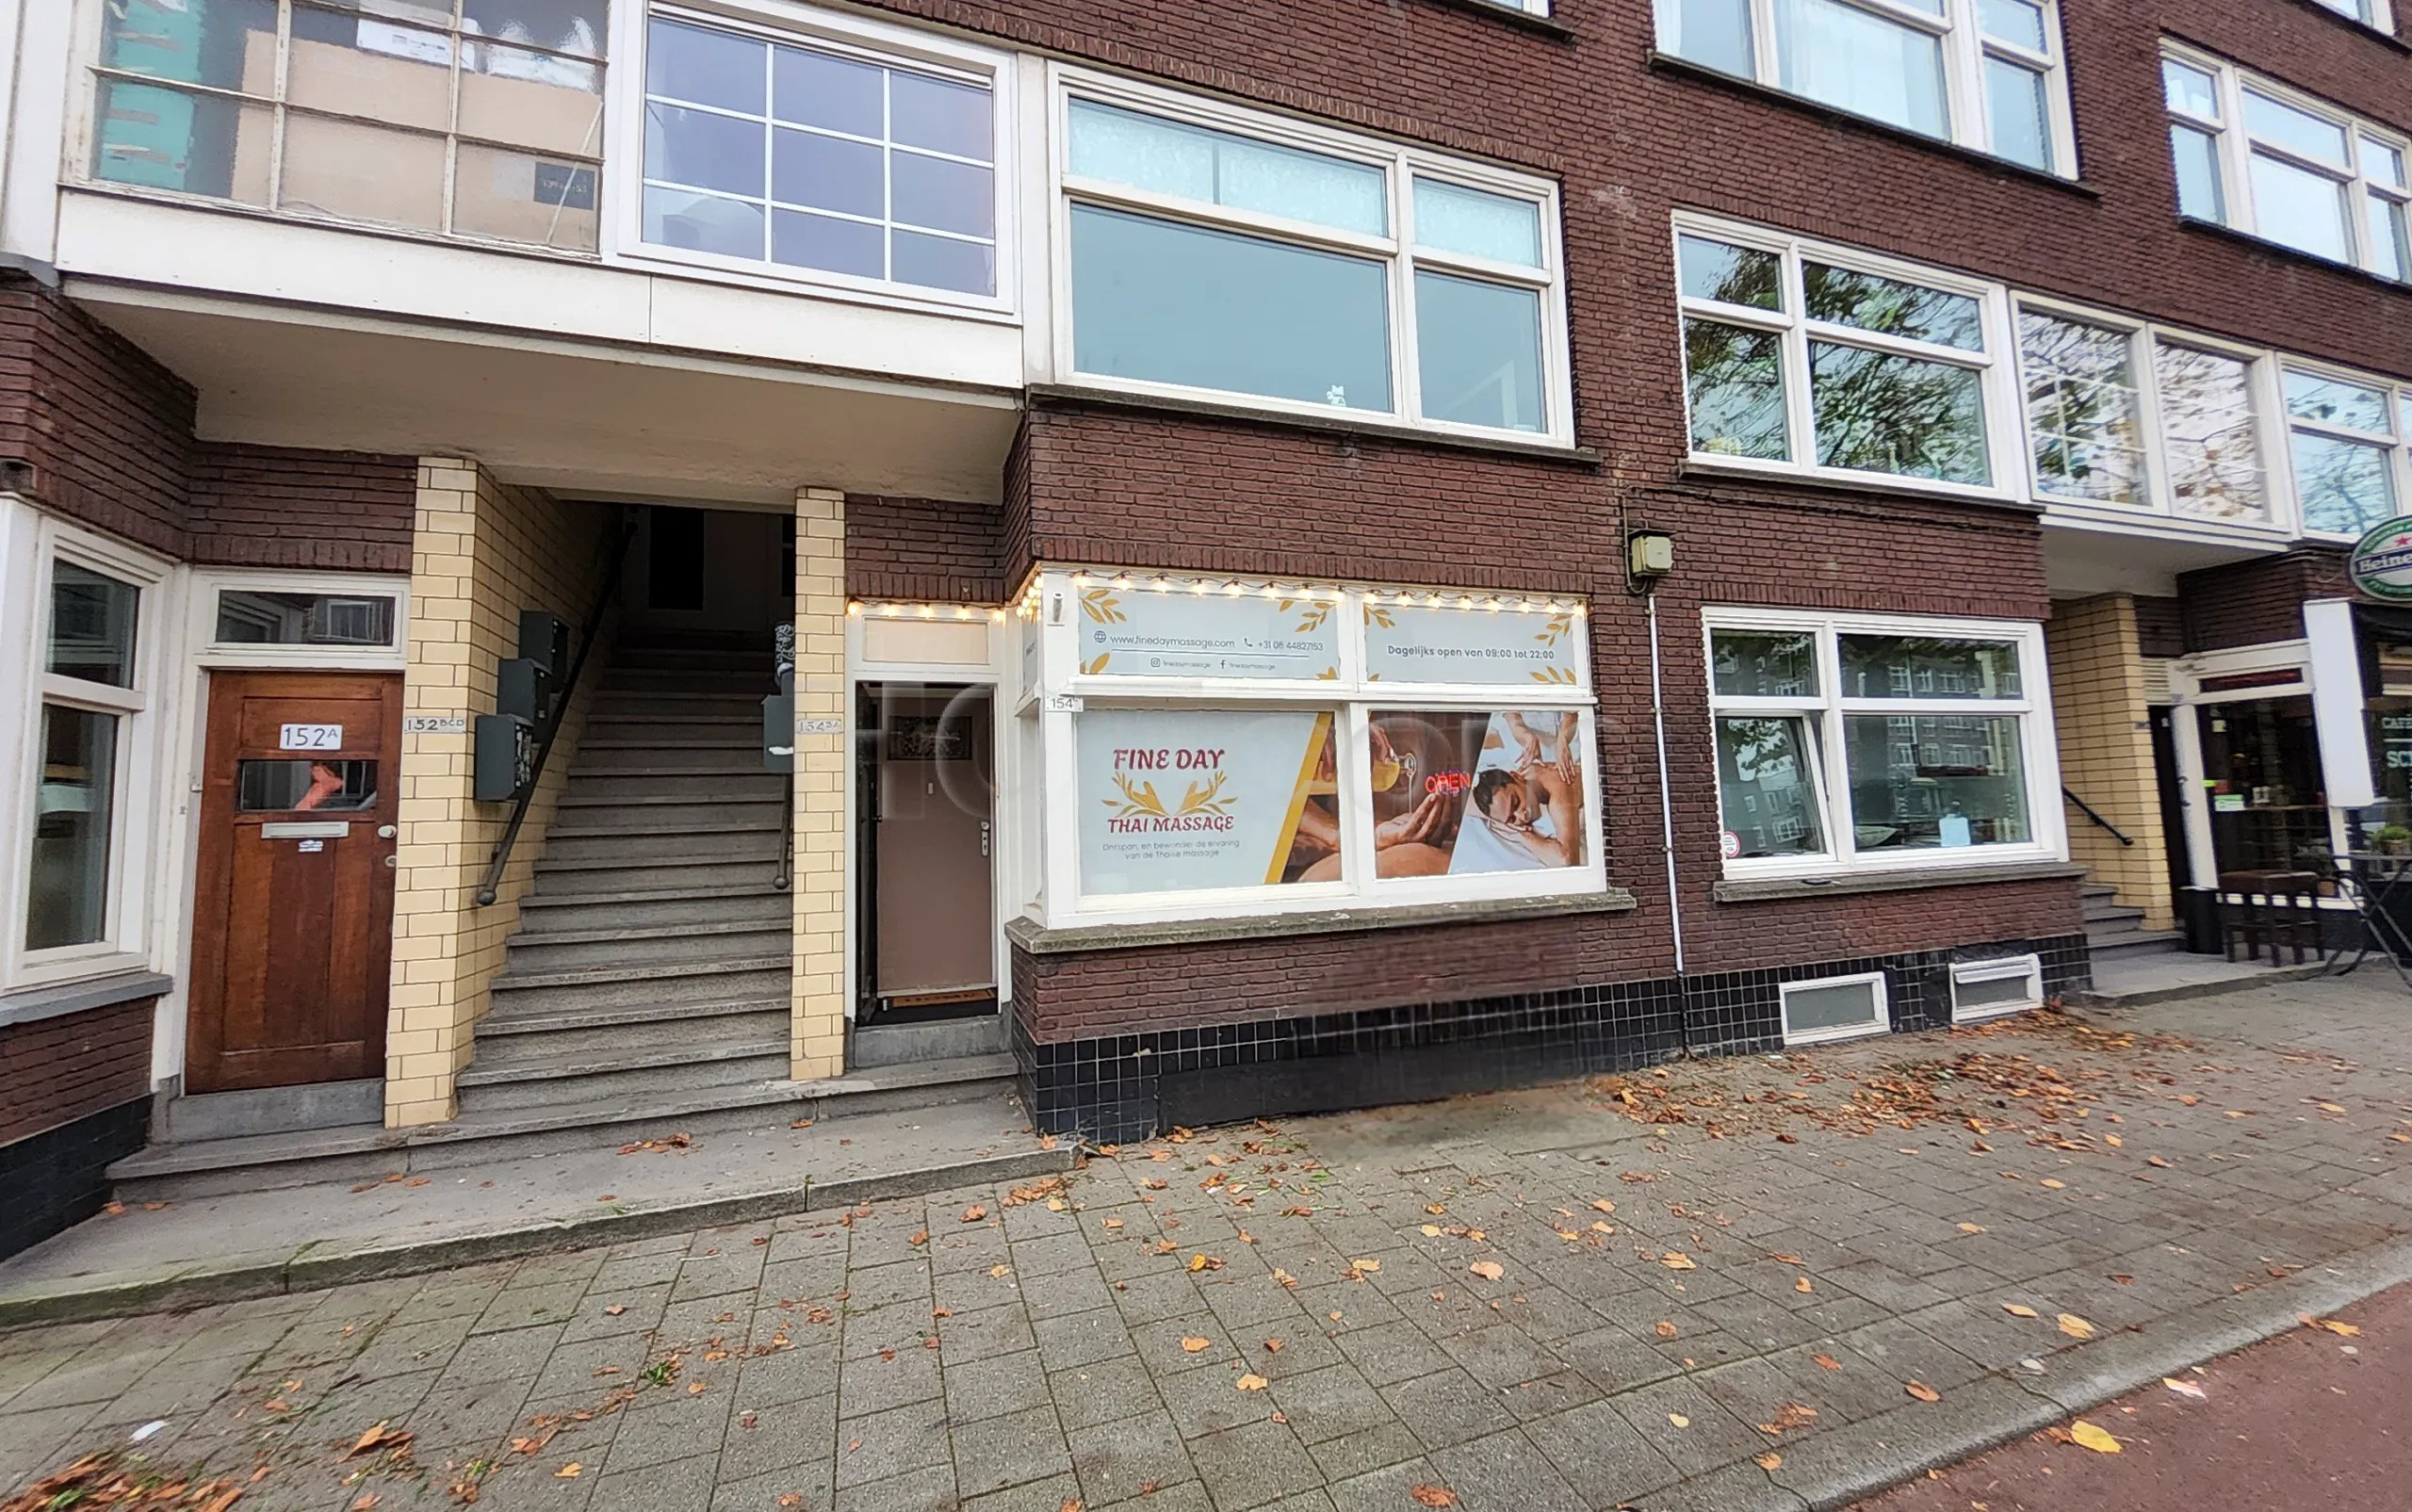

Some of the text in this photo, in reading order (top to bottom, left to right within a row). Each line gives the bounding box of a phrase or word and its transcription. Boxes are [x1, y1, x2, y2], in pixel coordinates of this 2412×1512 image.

[1110, 635, 1235, 649] www.finedaymassage.com
[1388, 645, 1555, 659] Dagelijks open van 09:00 tot 22:00
[285, 727, 338, 746] 152A
[1113, 749, 1225, 770] FINE DAY
[2387, 750, 2412, 768] SC
[1425, 772, 1471, 793] OPEN
[1107, 816, 1234, 834] THAI MASSAGE
[1125, 852, 1141, 860] van
